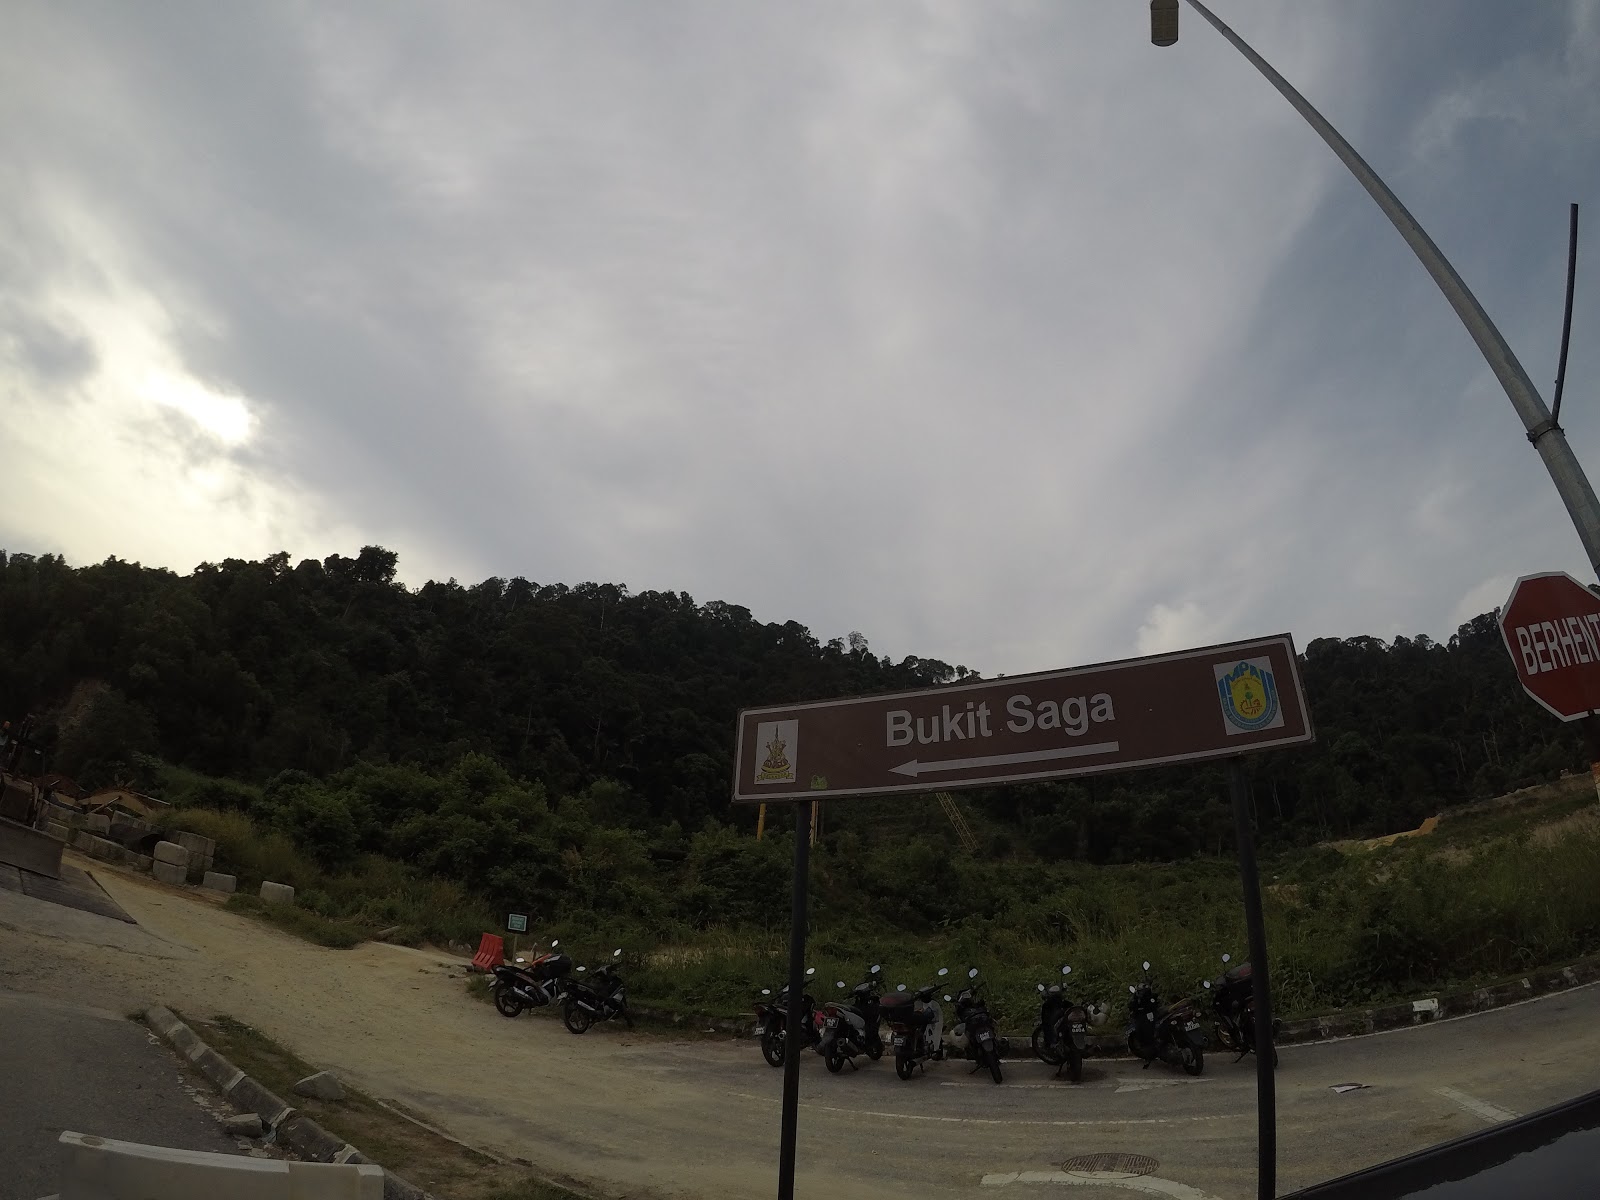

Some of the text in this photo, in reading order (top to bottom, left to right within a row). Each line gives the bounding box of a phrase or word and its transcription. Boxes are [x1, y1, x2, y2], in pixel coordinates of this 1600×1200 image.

[1515, 612, 1600, 676] BERHENT
[885, 692, 1116, 747] Bukit Saga
